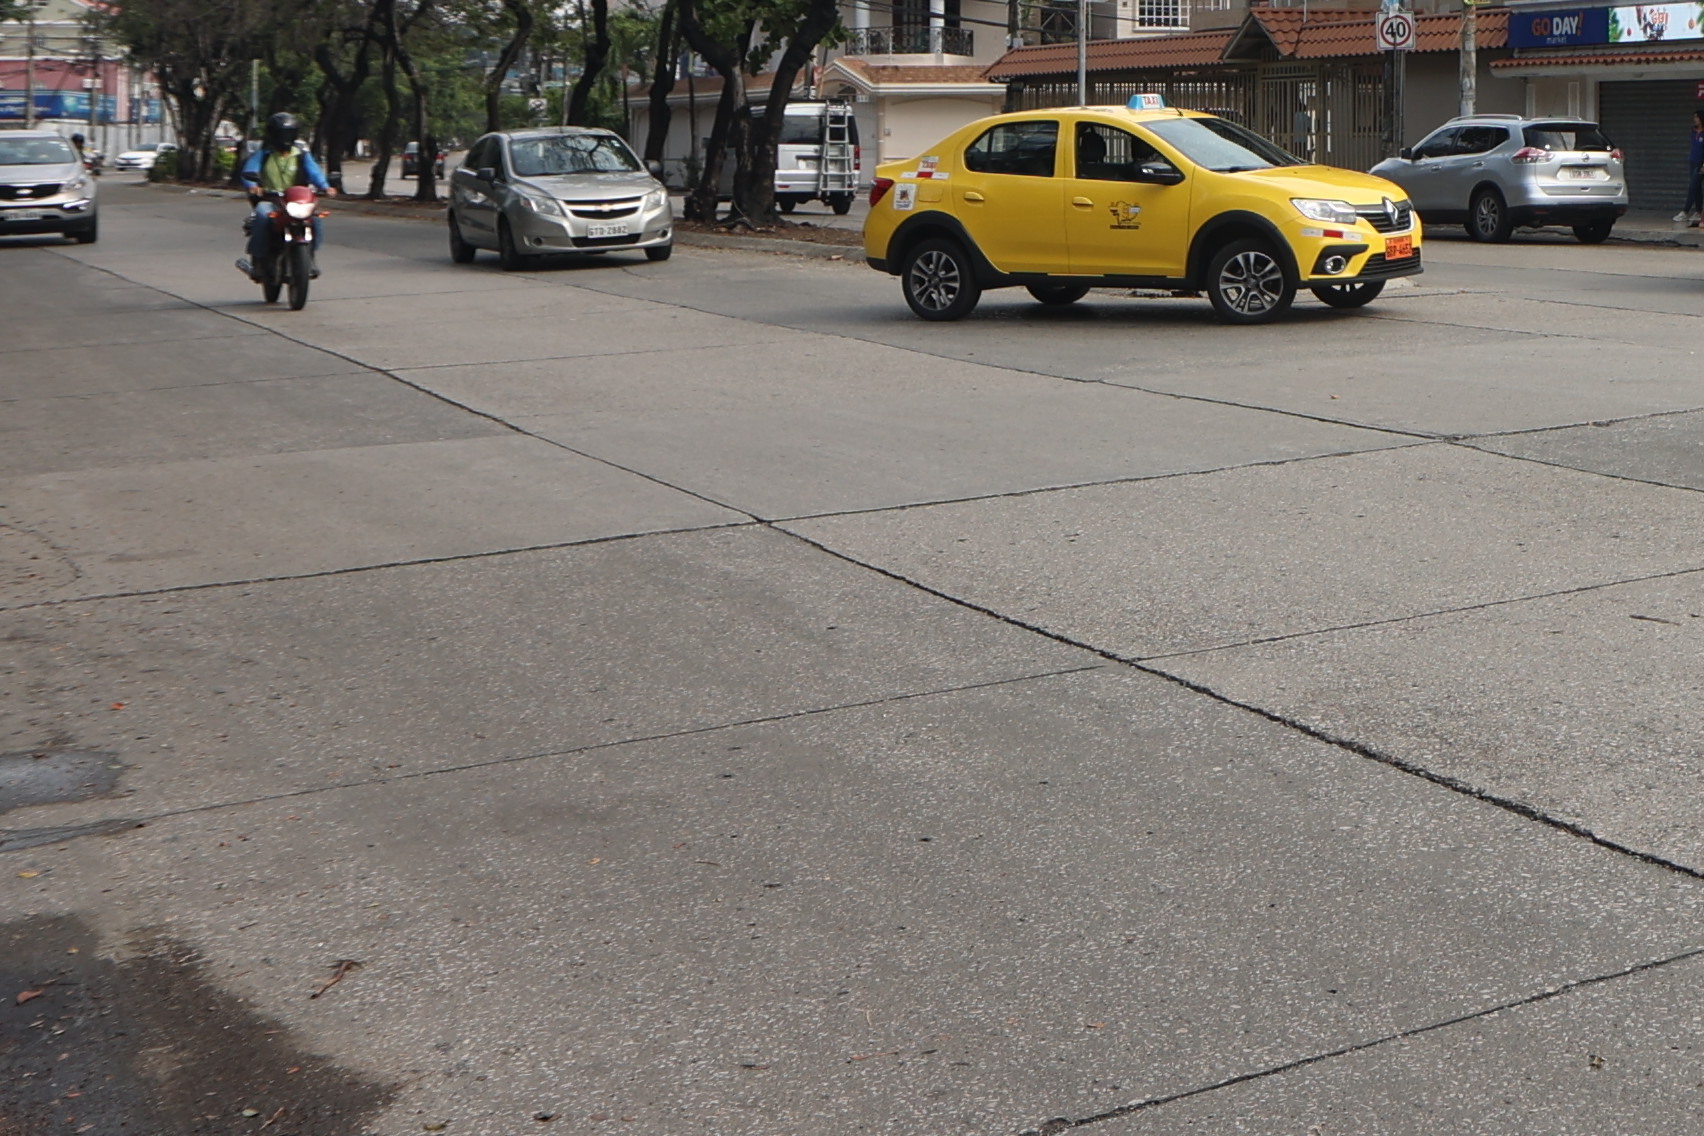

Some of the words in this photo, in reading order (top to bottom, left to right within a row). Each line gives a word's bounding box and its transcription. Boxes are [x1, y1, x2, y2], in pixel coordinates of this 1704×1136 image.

[1385, 21, 1406, 38] 40
[1531, 18, 1549, 36] GO
[1552, 11, 1584, 36] DAY!
[1546, 35, 1567, 45] market
[1142, 95, 1160, 105] TAXI
